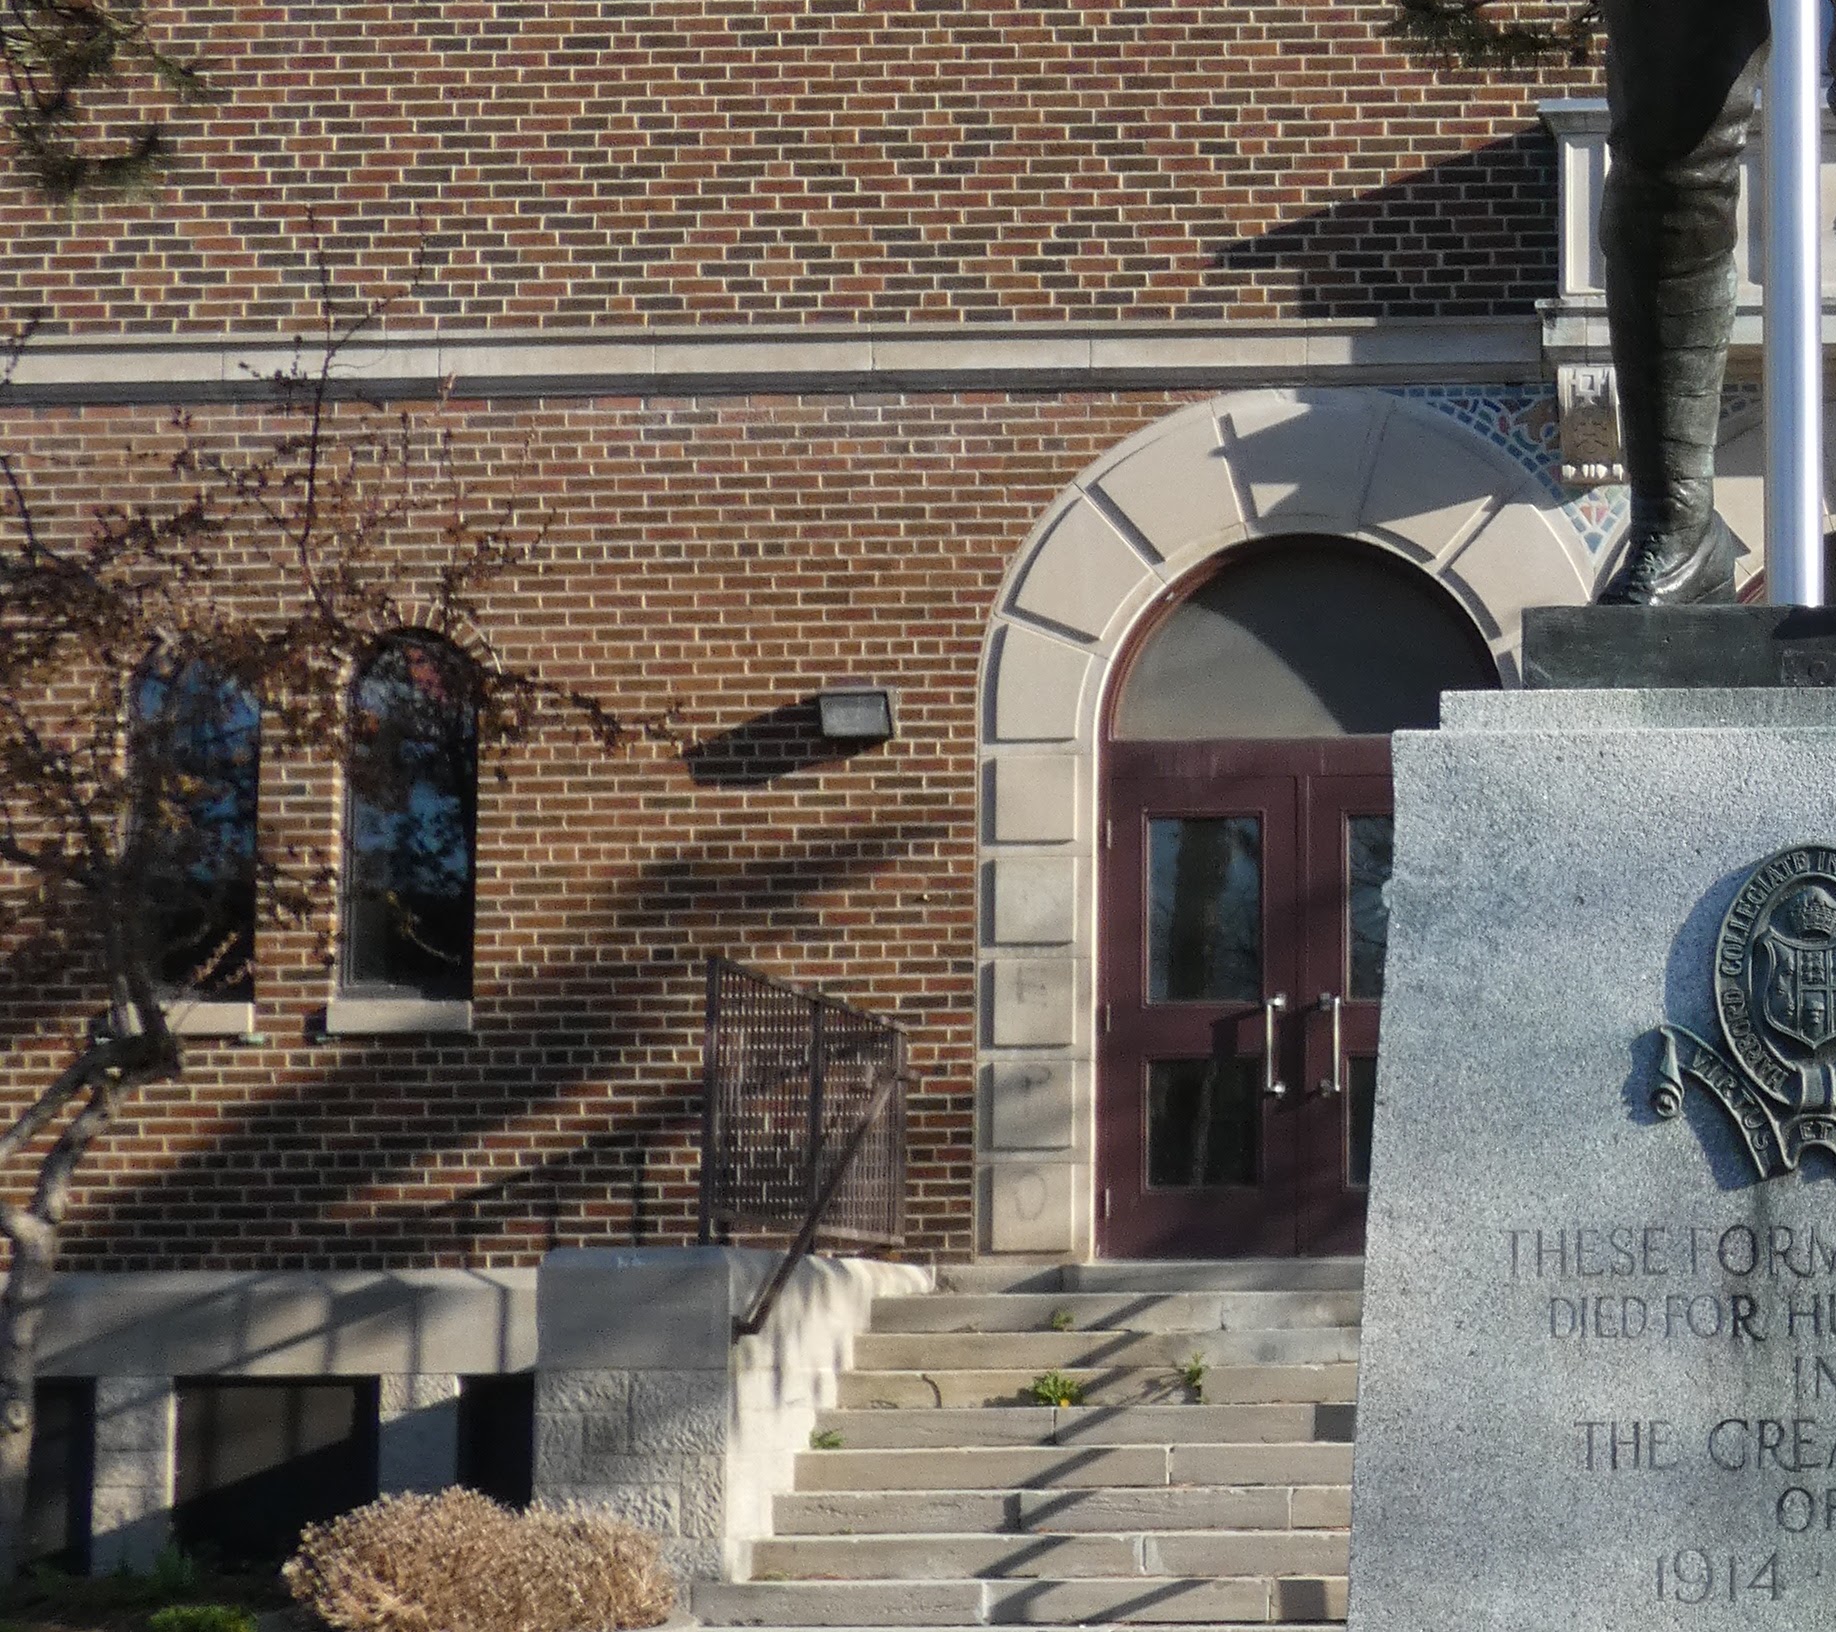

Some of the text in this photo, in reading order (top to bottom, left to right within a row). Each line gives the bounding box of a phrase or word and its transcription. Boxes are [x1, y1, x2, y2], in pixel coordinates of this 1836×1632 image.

[1720, 851, 1810, 976] COLLEGIATE
[1692, 1048, 1770, 1151] VIRTUS
[1801, 1121, 1834, 1141] ET
[1501, 1225, 1670, 1277] THESE
[1550, 1295, 1647, 1340] DIED
[1664, 1294, 1768, 1343] FOR
[1574, 1419, 1684, 1471] THE
[1655, 1548, 1785, 1605] 1914
